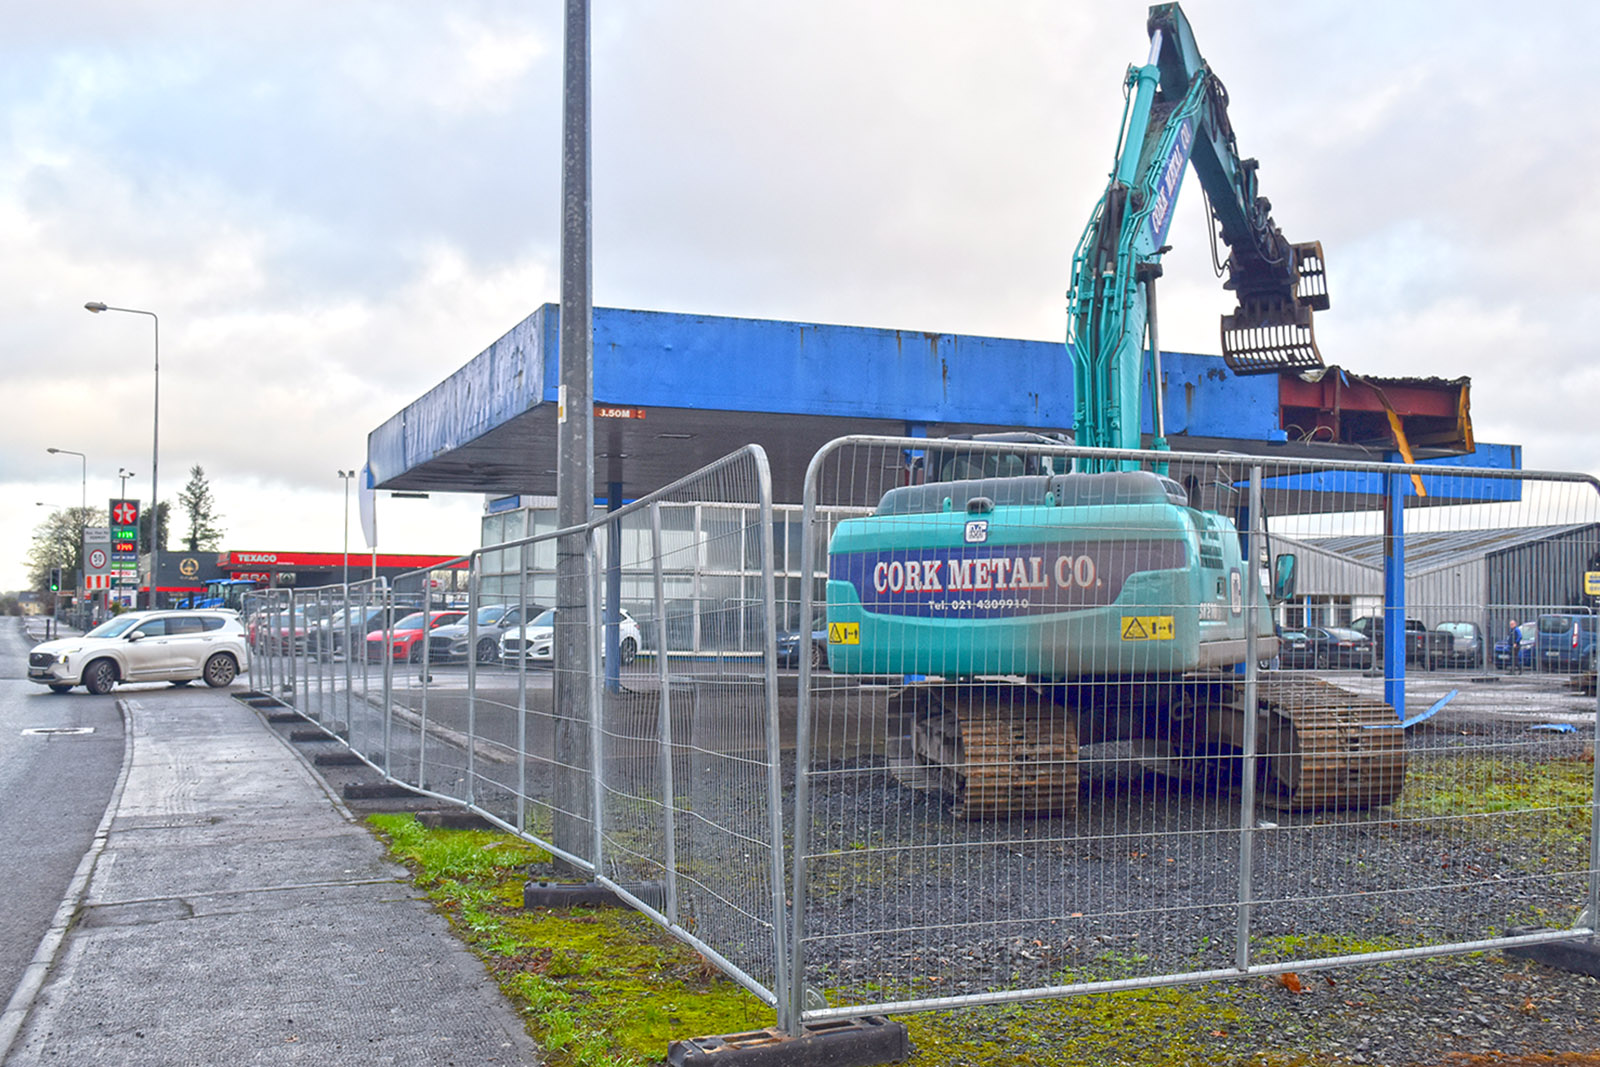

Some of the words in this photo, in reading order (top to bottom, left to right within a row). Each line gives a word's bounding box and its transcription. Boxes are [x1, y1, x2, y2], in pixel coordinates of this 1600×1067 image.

[94, 554, 102, 562] 50
[238, 554, 277, 562] TEXACO
[873, 560, 943, 593] CORK
[948, 557, 1049, 592] METAL
[1055, 555, 1102, 588] CO.
[929, 600, 948, 610] Tel.
[951, 600, 972, 610] 021
[975, 599, 1029, 610] 4309910
